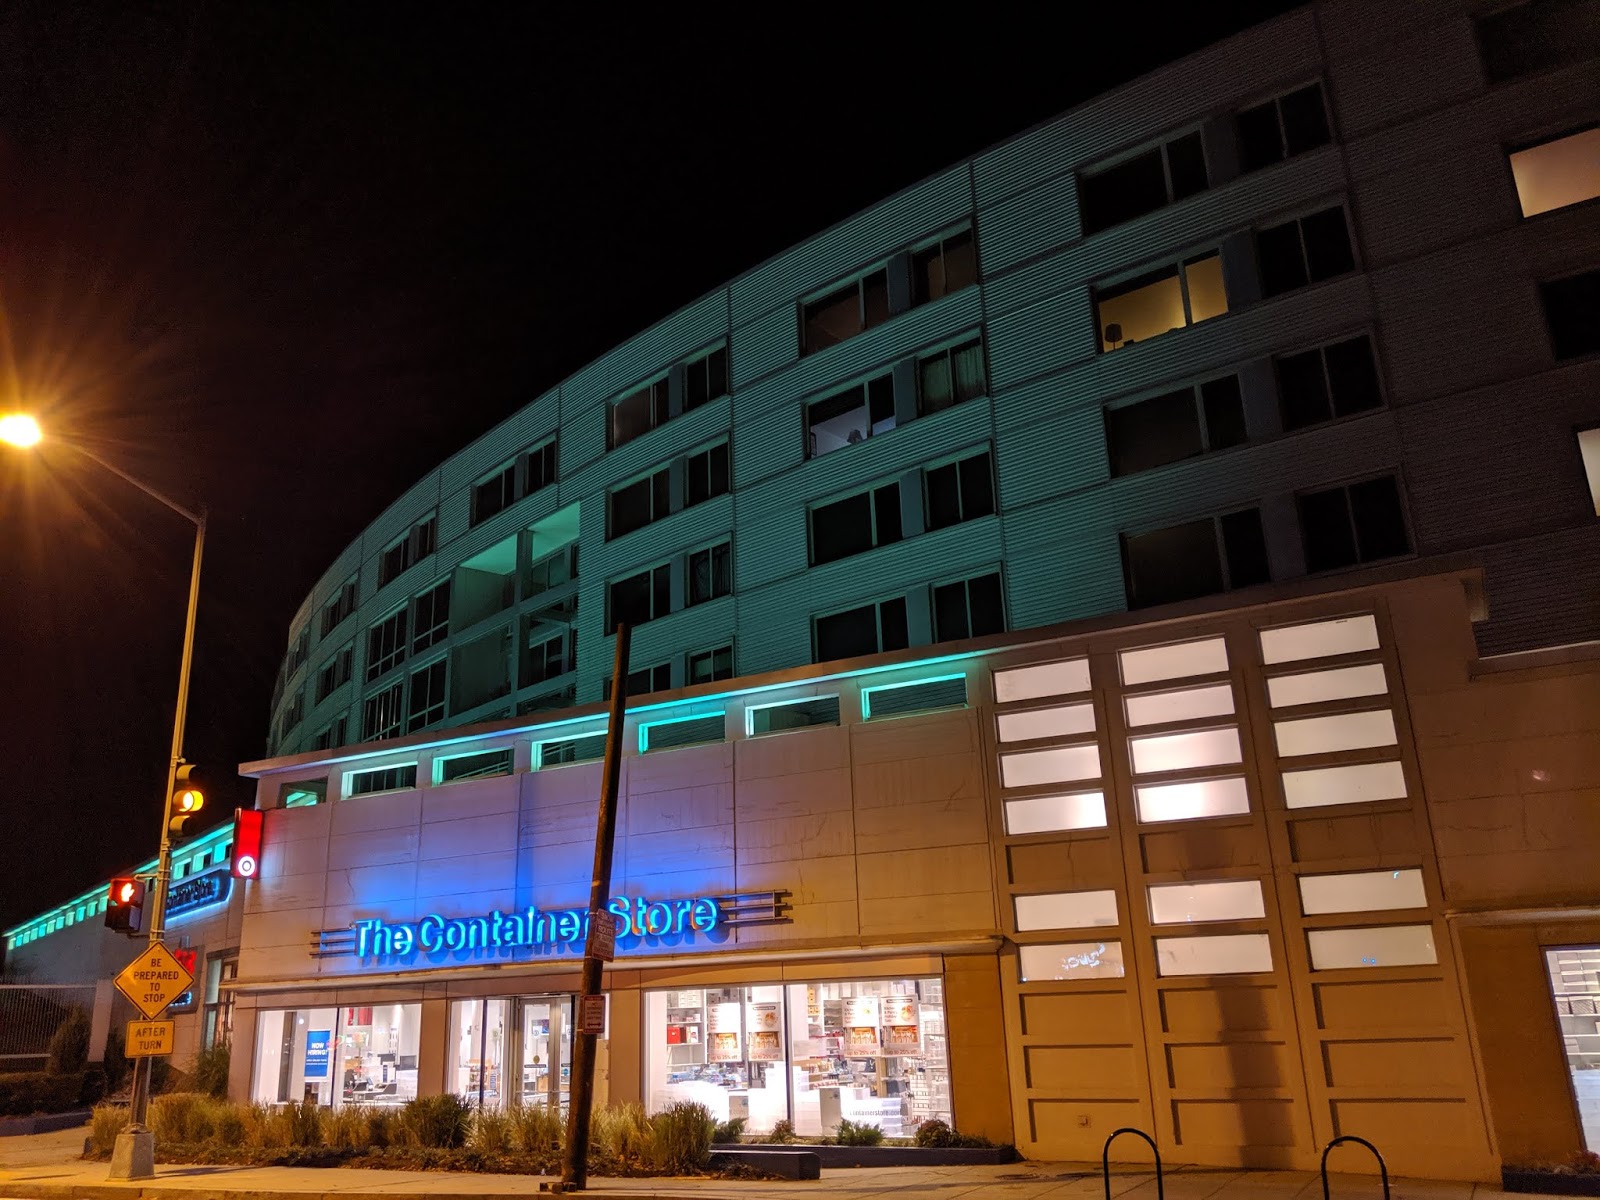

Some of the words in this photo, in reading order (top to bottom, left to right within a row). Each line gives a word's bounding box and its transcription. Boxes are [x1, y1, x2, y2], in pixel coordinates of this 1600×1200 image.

[355, 918, 413, 958] The
[606, 894, 719, 940] Store
[151, 958, 162, 968] BE
[133, 970, 179, 980] PREPARED
[150, 982, 160, 992] TO
[143, 993, 165, 1003] STOP
[136, 1027, 165, 1038] AFTER
[138, 1040, 162, 1050] TURN
